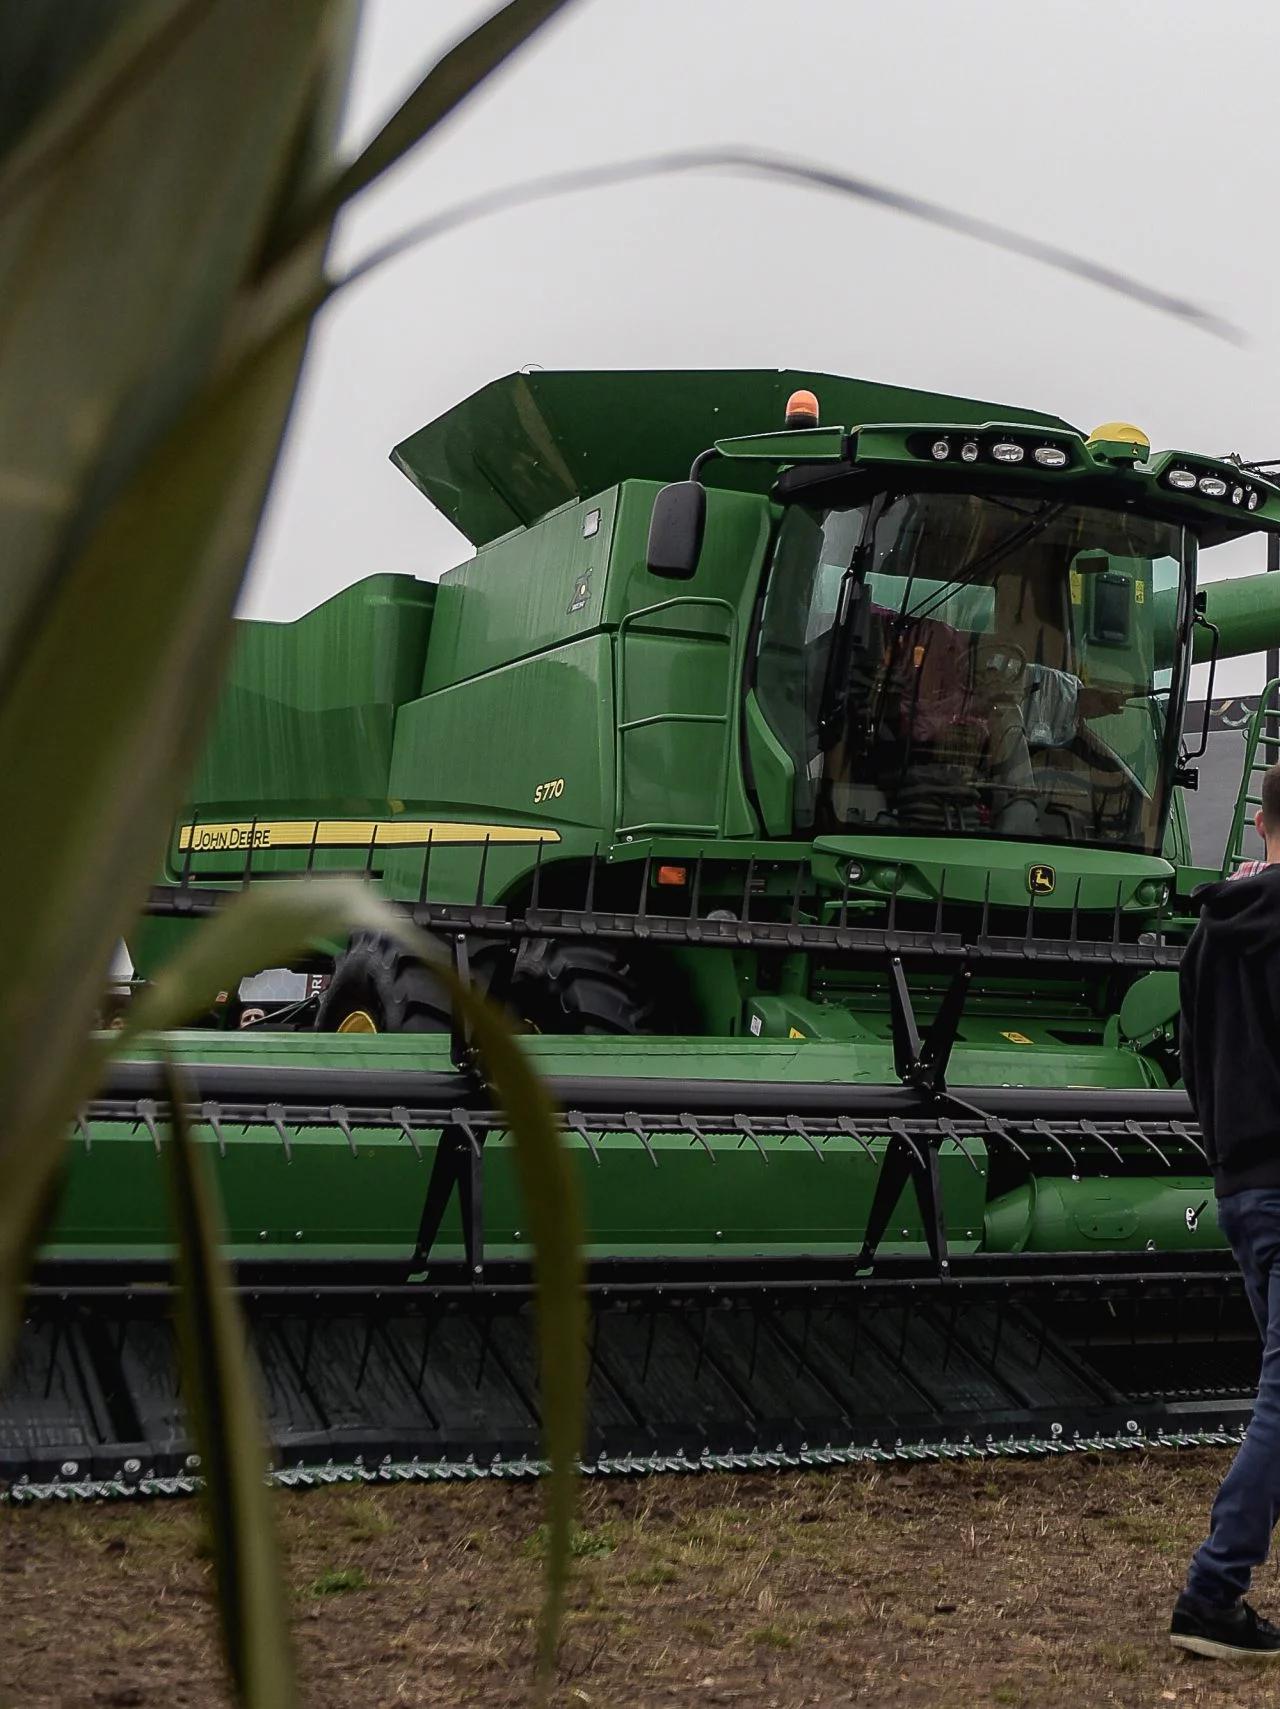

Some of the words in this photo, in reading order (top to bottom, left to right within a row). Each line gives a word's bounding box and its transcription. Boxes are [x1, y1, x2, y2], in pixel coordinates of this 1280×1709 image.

[534, 778, 564, 803] S770
[194, 829, 228, 848] JOHN
[229, 827, 271, 847] DEERE
